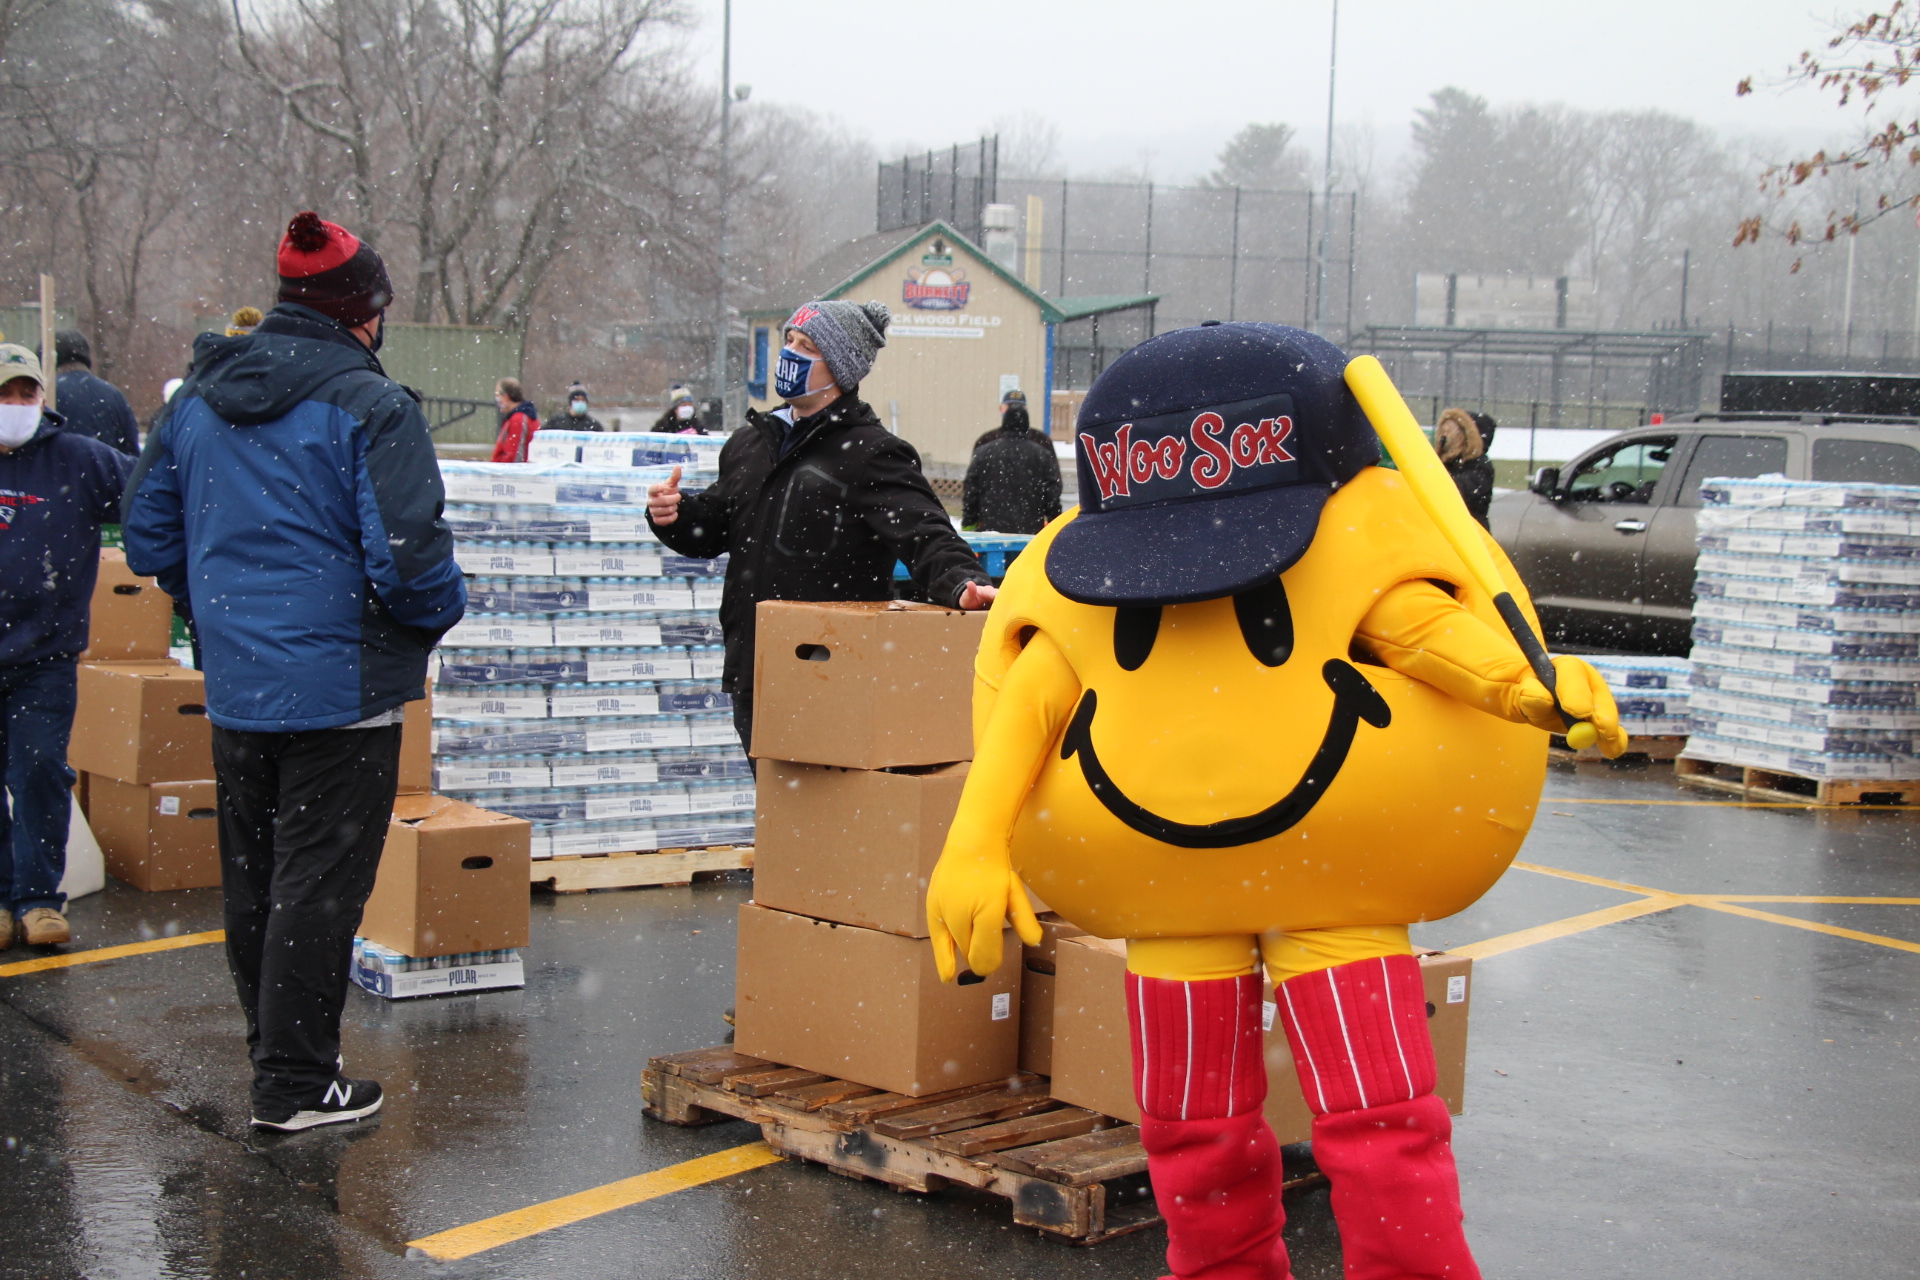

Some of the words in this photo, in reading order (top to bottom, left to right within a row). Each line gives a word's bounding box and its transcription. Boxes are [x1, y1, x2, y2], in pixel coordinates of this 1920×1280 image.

[905, 282, 968, 301] BURNETT
[959, 314, 1002, 327] FIELD
[491, 483, 516, 498] POLAR
[490, 556, 514, 571] POLAR
[601, 557, 624, 571] POLAR
[633, 592, 656, 606] POLAR
[489, 628, 513, 642] POLAR
[600, 628, 623, 641] POLAR
[632, 662, 655, 676] POLAR
[480, 700, 505, 714] POLAR
[597, 699, 620, 712] POLAR
[448, 968, 477, 987] POLAR
